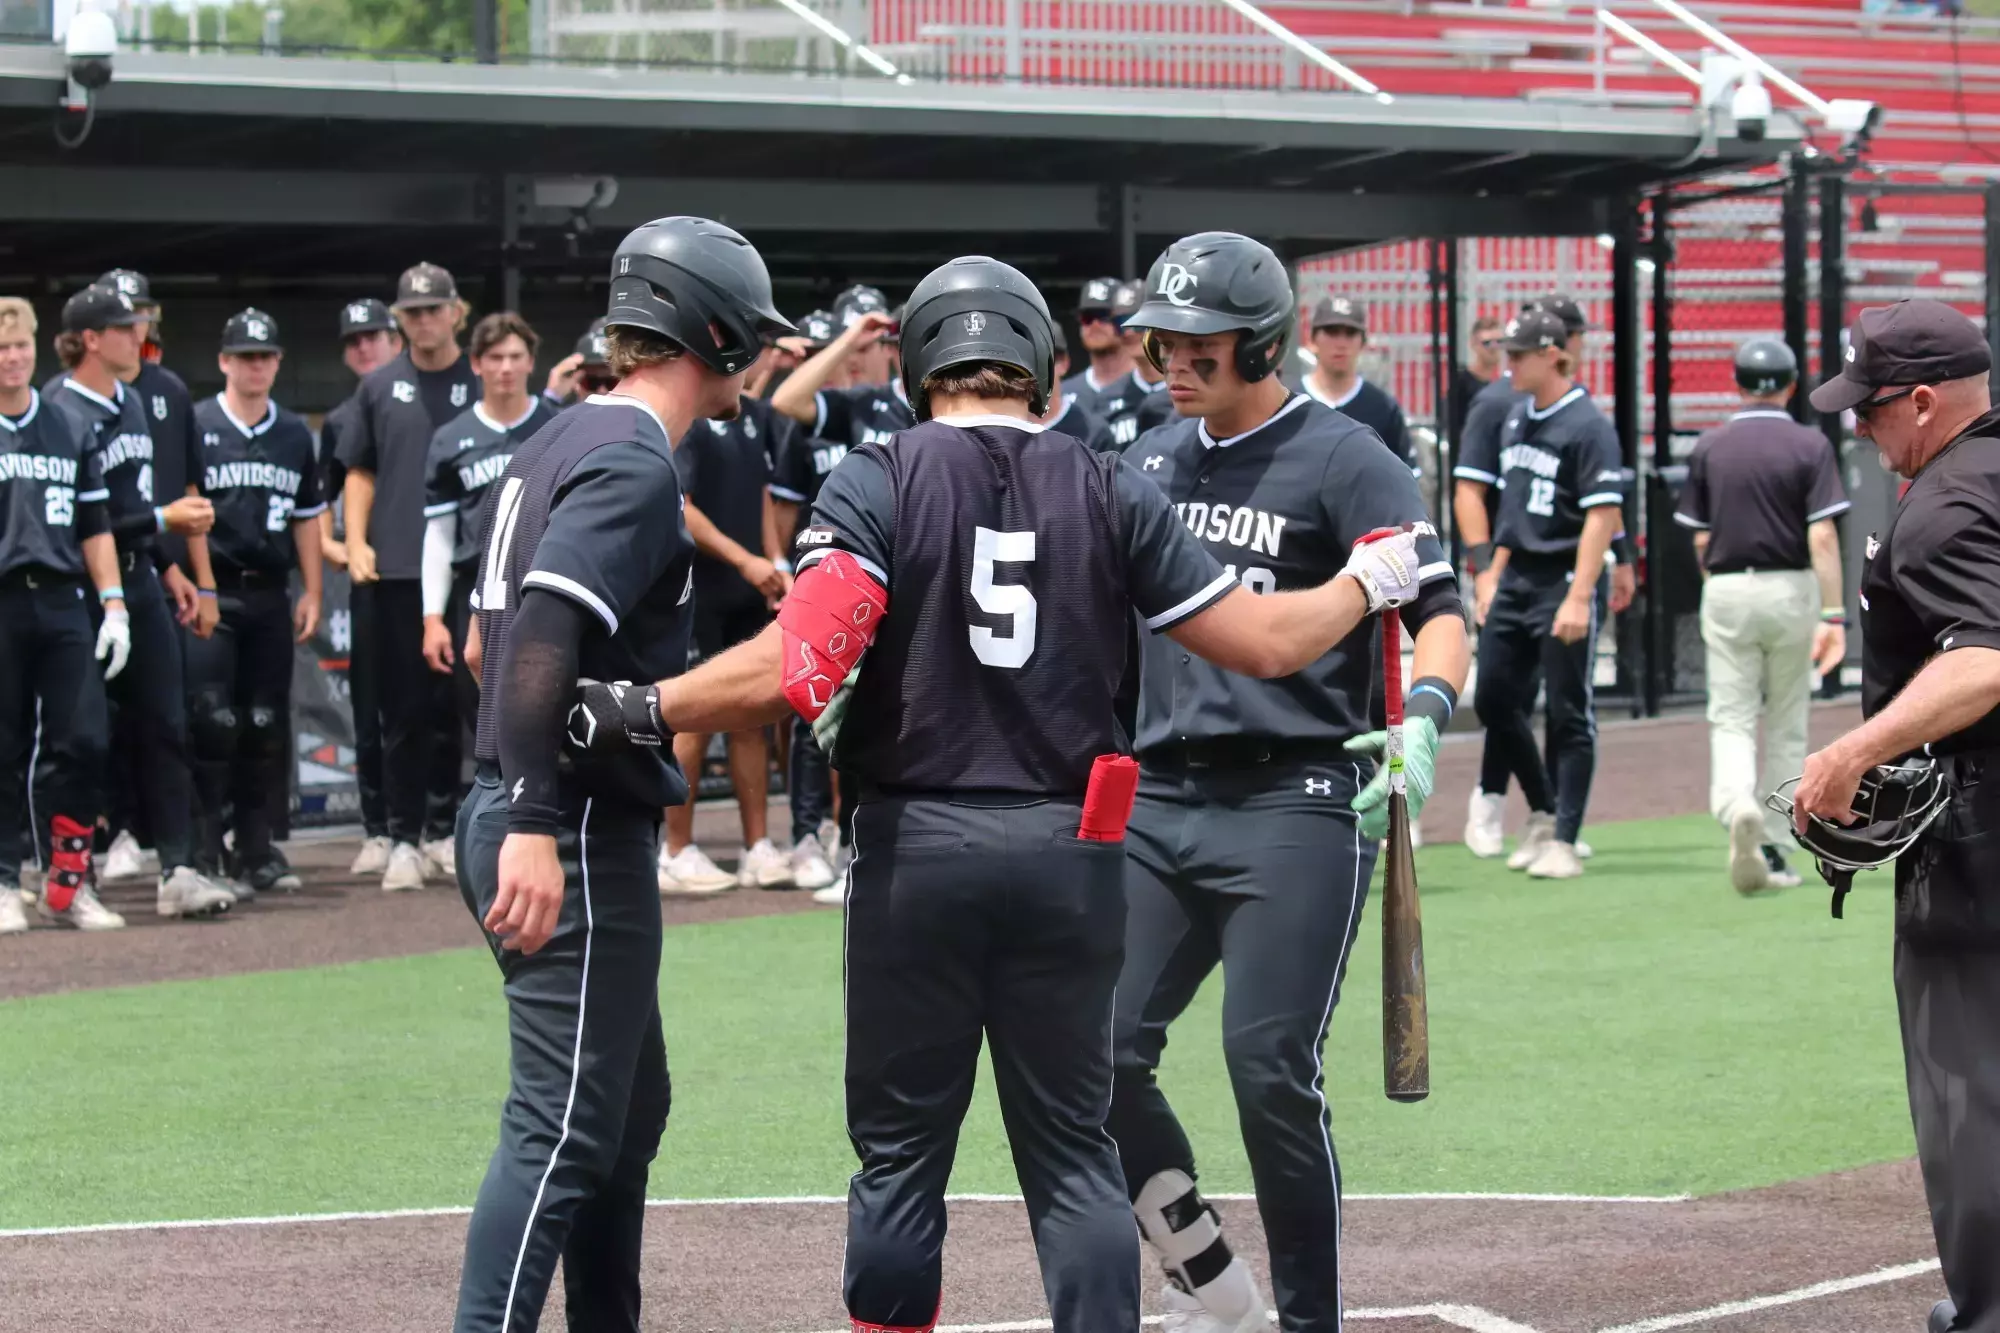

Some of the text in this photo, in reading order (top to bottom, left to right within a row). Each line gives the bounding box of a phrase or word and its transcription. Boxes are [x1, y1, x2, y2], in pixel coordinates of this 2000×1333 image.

[1156, 263, 1198, 306] DC
[970, 314, 979, 330] 5
[0, 453, 77, 485] VIDSON
[204, 462, 302, 496] DAVIDSON
[44, 485, 76, 527] 25
[1526, 477, 1555, 516] 12
[1172, 502, 1287, 558] DSON
[968, 525, 1038, 669] 5
